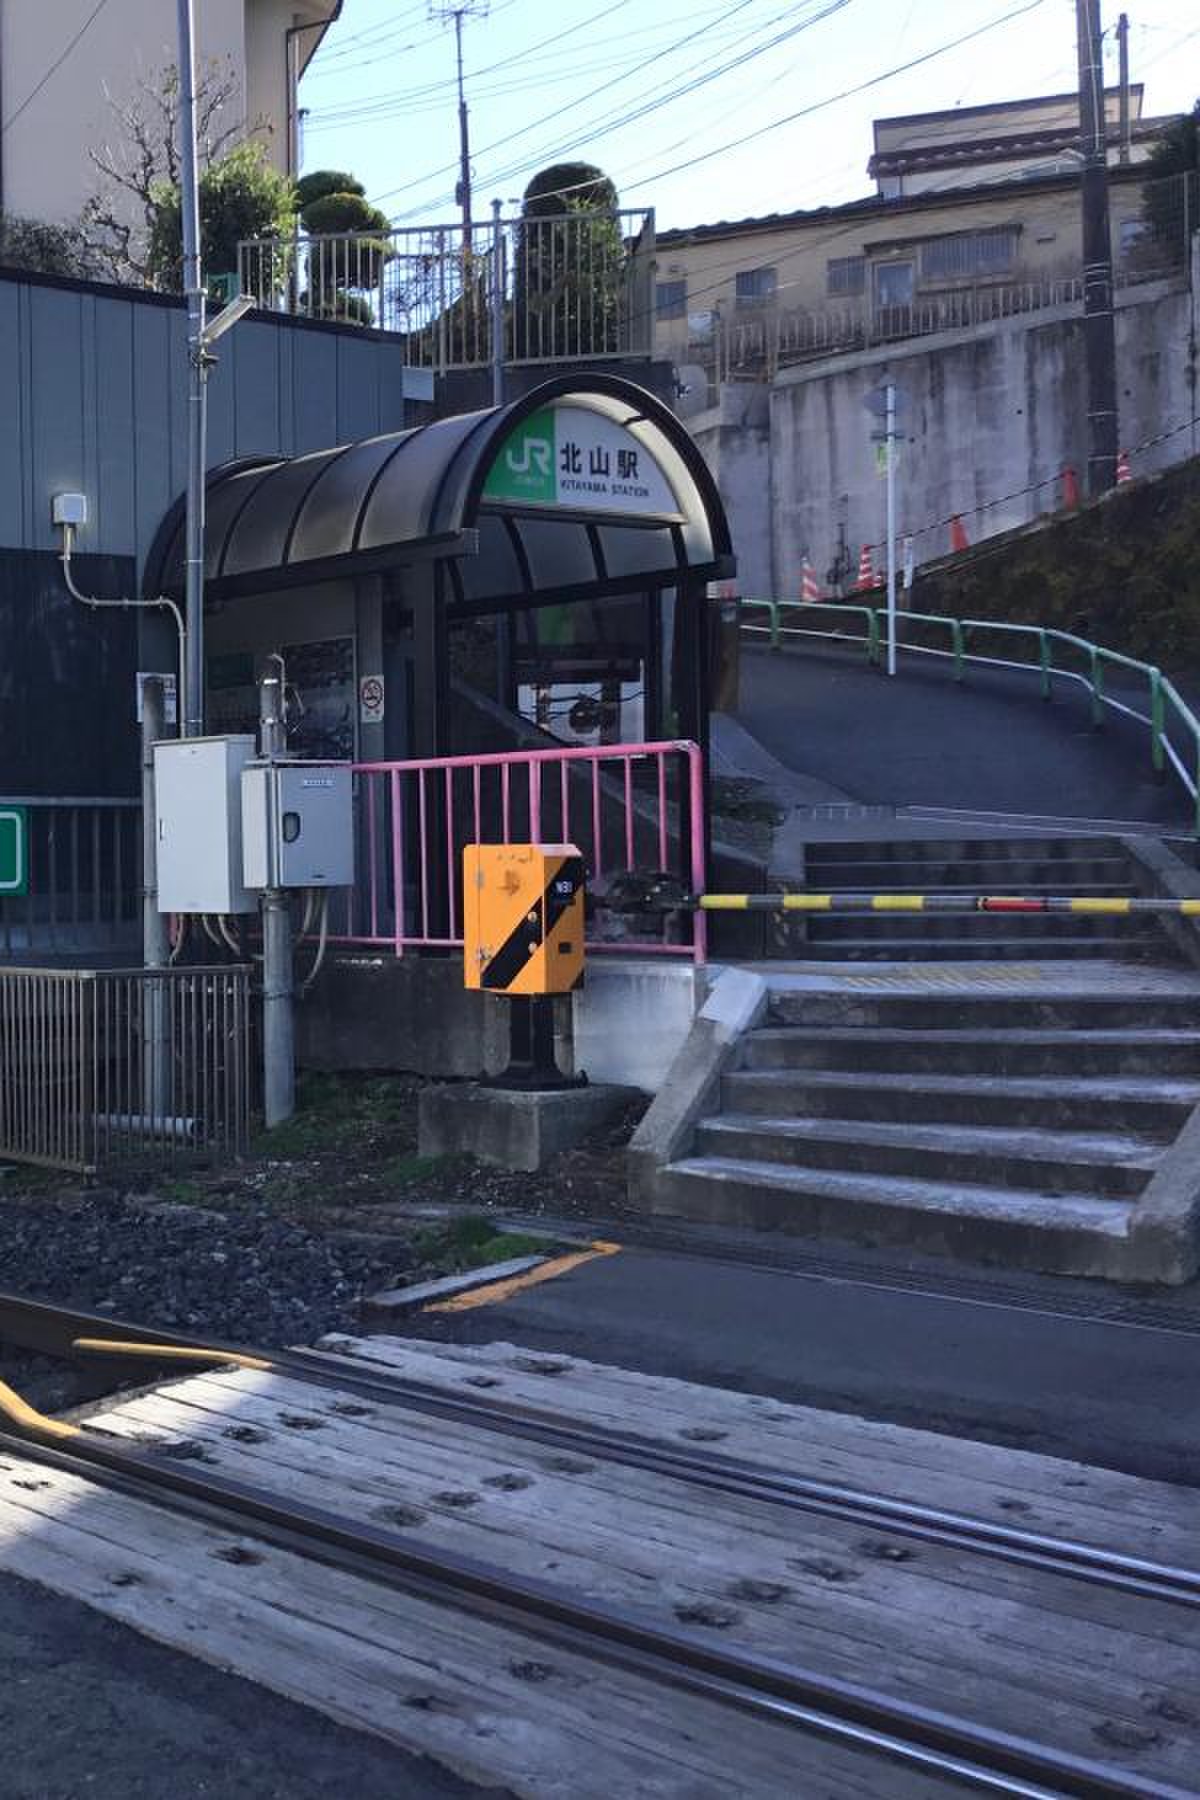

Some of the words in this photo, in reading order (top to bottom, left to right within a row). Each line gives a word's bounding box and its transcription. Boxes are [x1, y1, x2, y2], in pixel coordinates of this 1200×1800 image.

[506, 438, 550, 475] JR
[560, 442, 640, 480] 北山駅
[560, 479, 607, 494] KITAYAMA
[611, 484, 650, 498] STATION
